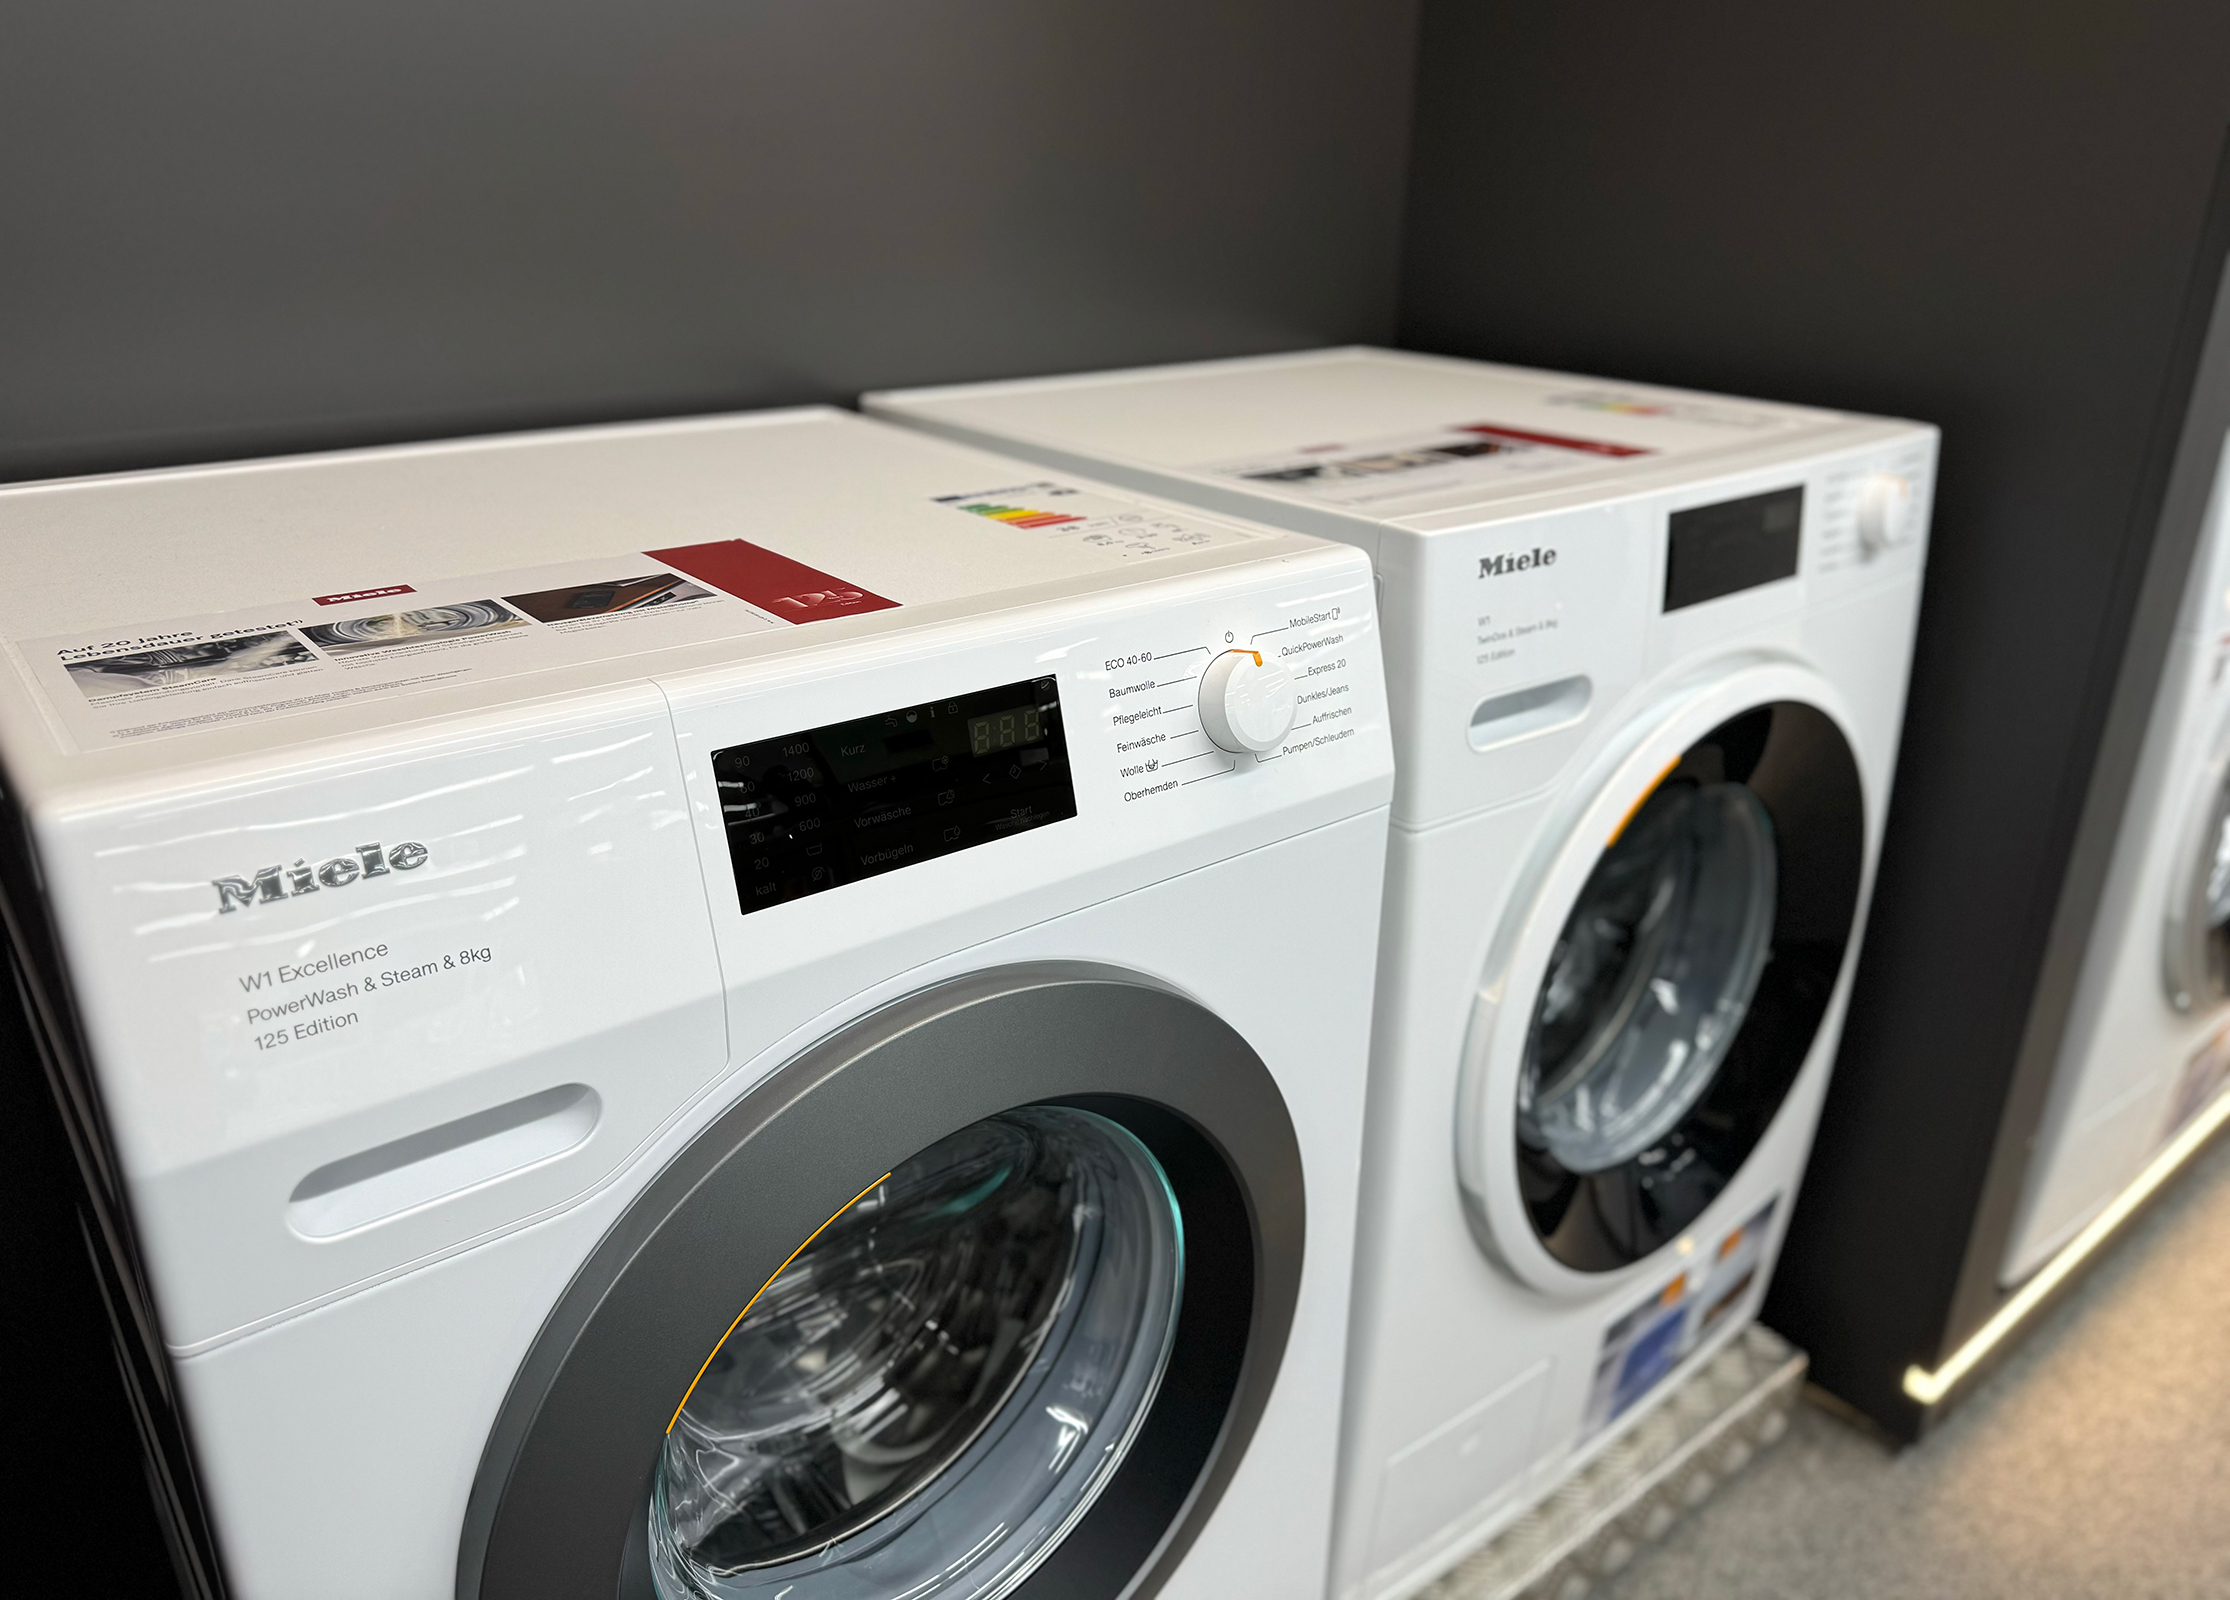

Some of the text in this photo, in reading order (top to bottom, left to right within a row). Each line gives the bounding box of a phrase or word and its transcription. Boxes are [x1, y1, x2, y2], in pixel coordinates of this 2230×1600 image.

[1478, 548, 1556, 579] Miele
[1289, 611, 1331, 629] MobileStart
[57, 631, 193, 655] Auf 20 Jahre
[60, 634, 203, 660] Lebensdauer
[1281, 634, 1344, 658] QuickPowerWash
[1105, 651, 1153, 672] ECO 40-60
[1308, 658, 1347, 678] Express 20
[1109, 679, 1156, 699] Baumwolle
[1297, 683, 1350, 705] Dunkles/Jeans
[1112, 705, 1162, 726] Pflegeleicht
[1312, 706, 1352, 725] Auffrischen
[782, 742, 810, 757] 1400
[840, 743, 866, 758] Kurz
[1116, 731, 1167, 754] Feinwäsche
[1282, 728, 1355, 757] Pumpen/Schleudern
[734, 755, 751, 769] 90
[1120, 763, 1144, 779] Wolle
[786, 767, 815, 782] 1200
[847, 776, 888, 794] Wasser
[1124, 779, 1178, 803] Oberhemden
[794, 792, 817, 808] 900
[854, 805, 912, 829] Vorwäsche
[1010, 805, 1032, 819] Start
[799, 818, 821, 832] 600
[749, 831, 765, 845] 30
[754, 856, 770, 870] 20
[860, 842, 914, 866] Vorbügeln
[212, 840, 430, 915] Miele
[755, 881, 777, 896] kalt
[238, 943, 389, 993] W1 Excellence
[246, 946, 492, 1025] PowerWash & Steam & 8kg
[253, 1010, 359, 1051] 125 Edition
